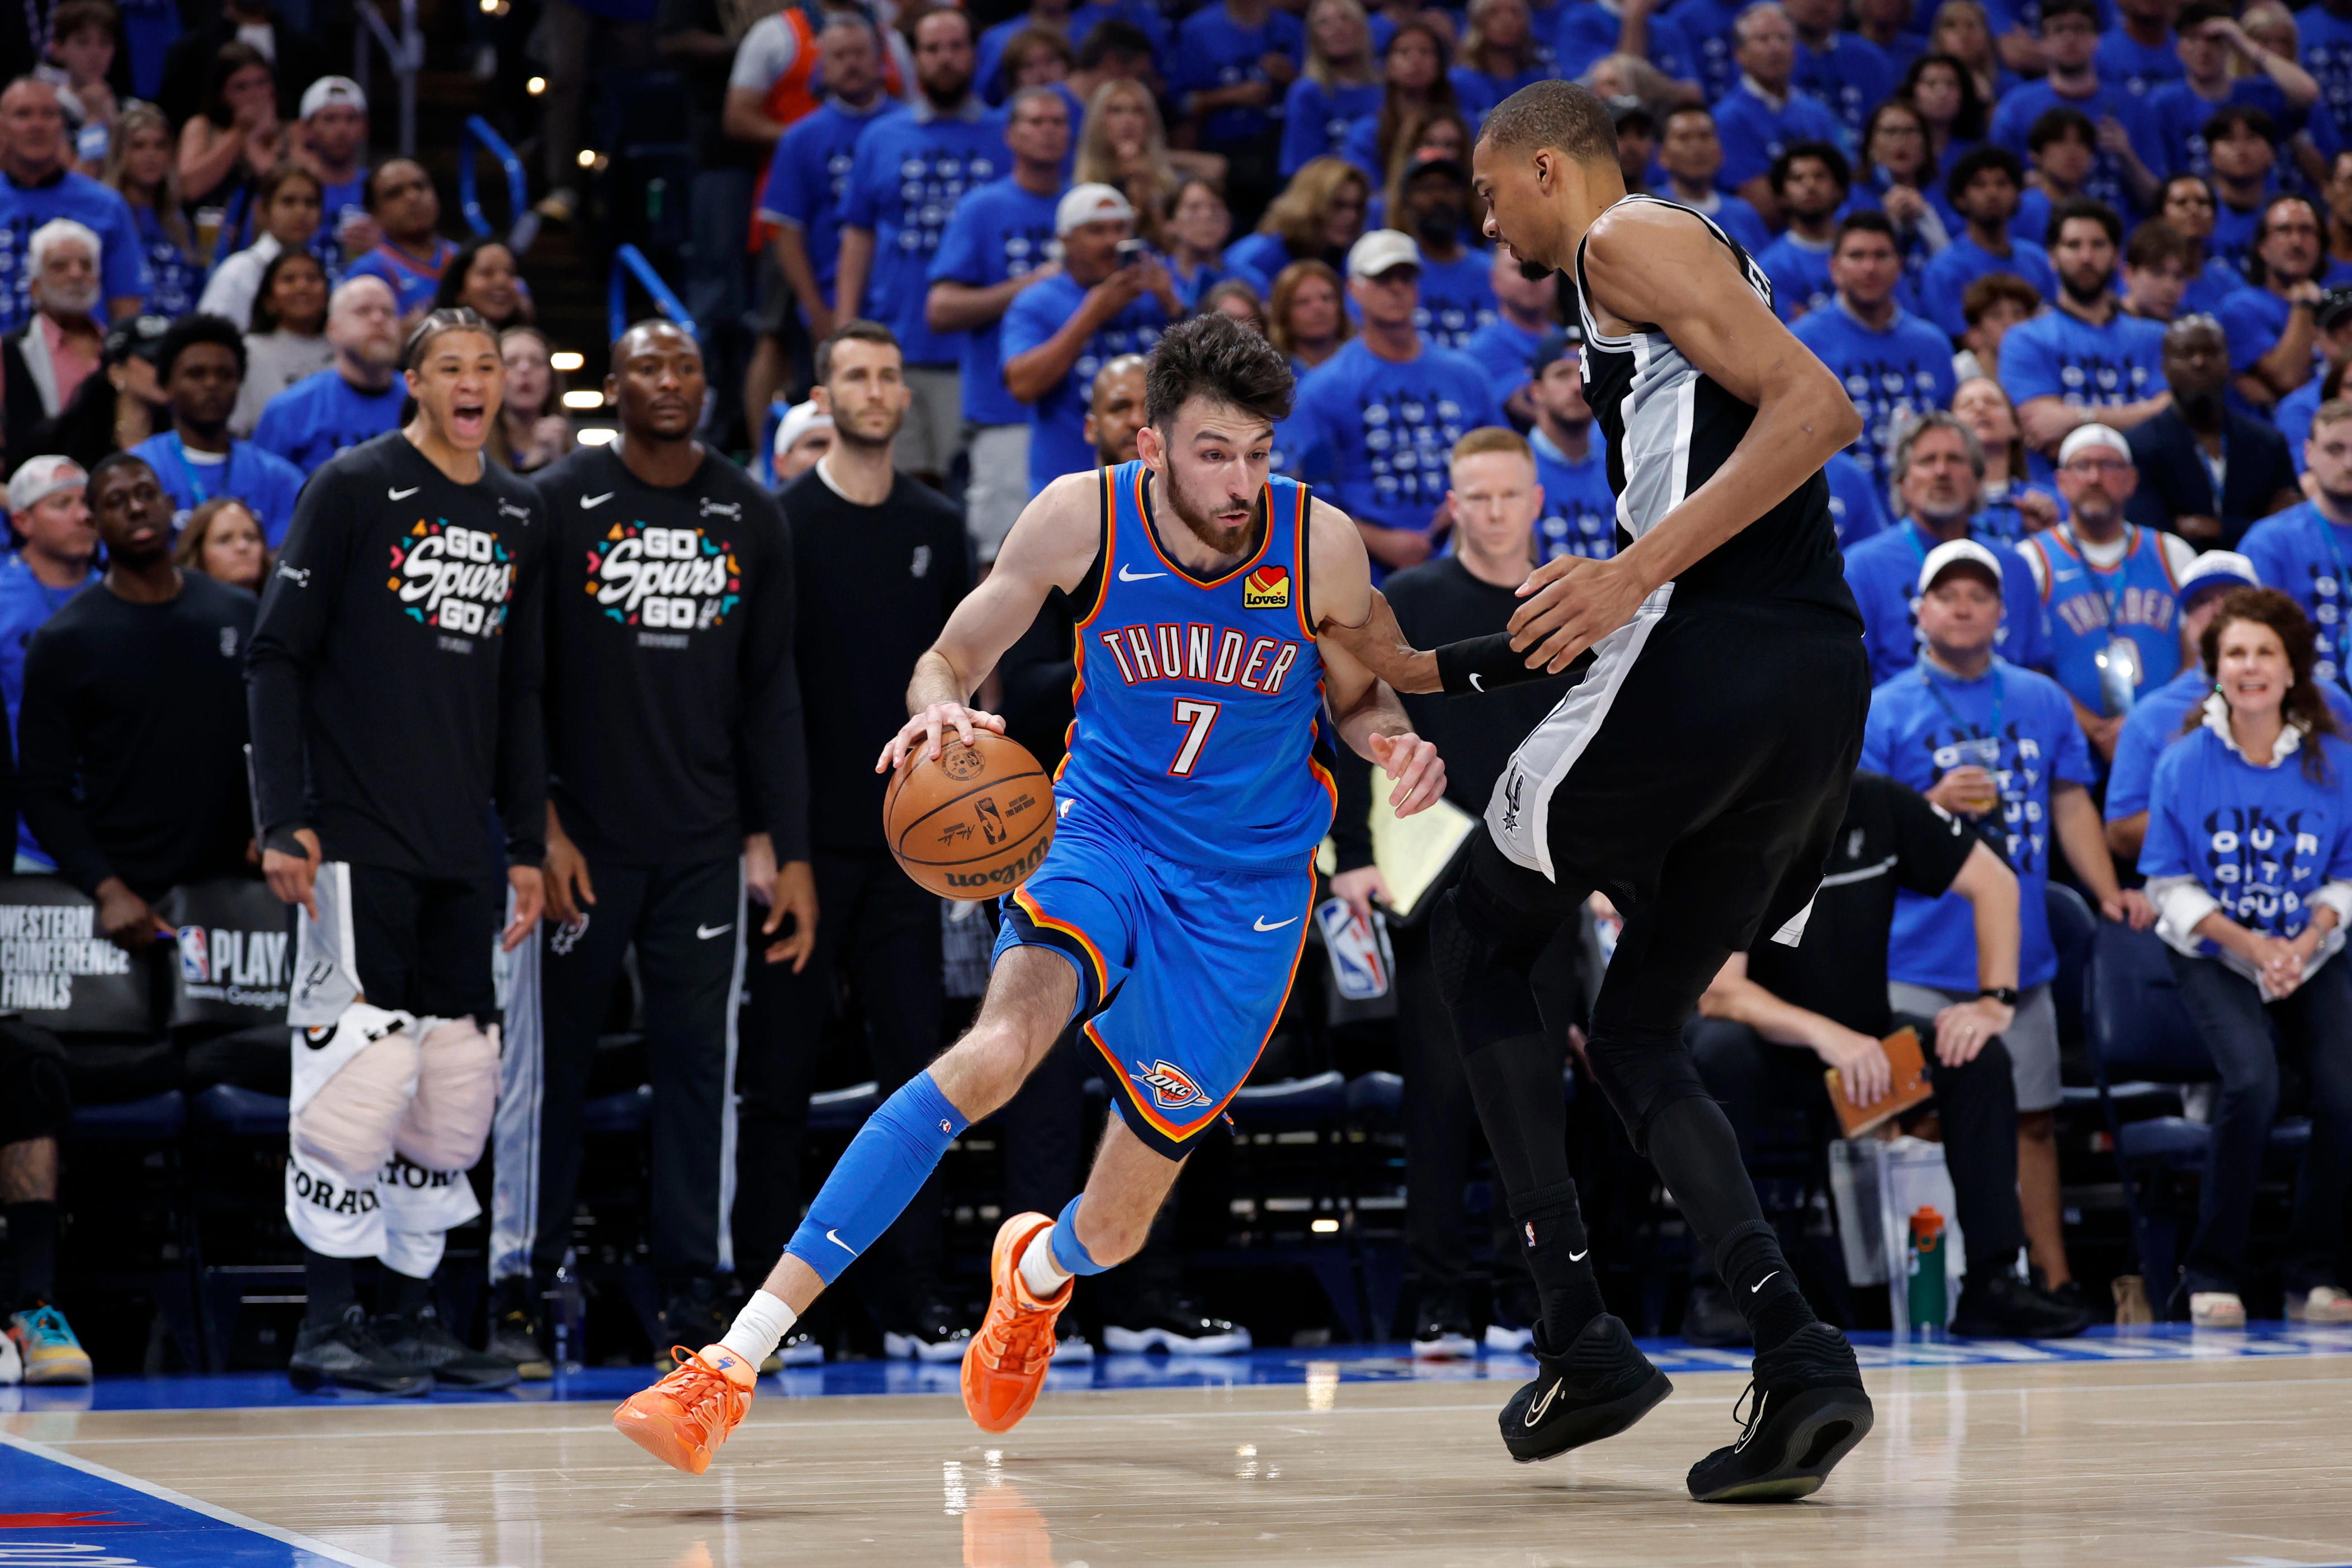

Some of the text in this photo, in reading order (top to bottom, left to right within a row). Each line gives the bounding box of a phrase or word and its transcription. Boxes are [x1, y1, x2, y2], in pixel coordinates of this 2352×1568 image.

[445, 525, 493, 563] GO
[643, 527, 698, 559] GO
[399, 535, 512, 611] Spurs
[596, 537, 727, 611] Spurs
[438, 597, 485, 635] GO
[641, 596, 697, 629] GO
[1099, 622, 1299, 695] THUNDER
[1166, 697, 1221, 778] 7
[2212, 828, 2318, 856] OUR
[944, 835, 1050, 888] Wilson
[0, 904, 95, 938] WESTERN
[1, 938, 130, 975] CONFERENCE
[211, 928, 292, 986] PLAY
[2, 974, 72, 1009] FINALS
[1145, 1074, 1192, 1096] OKC
[287, 1155, 381, 1214] ORAD
